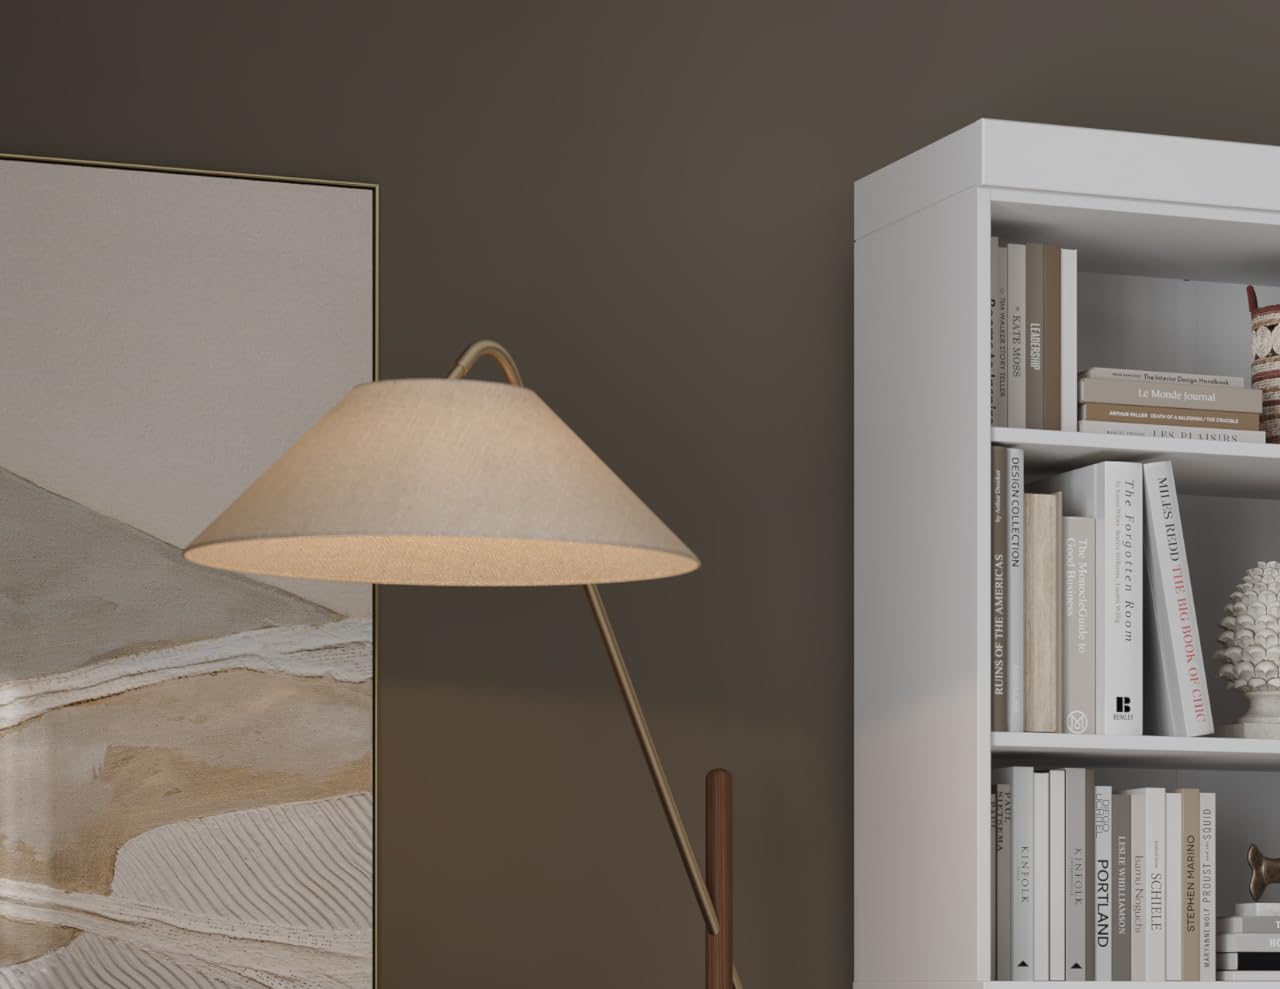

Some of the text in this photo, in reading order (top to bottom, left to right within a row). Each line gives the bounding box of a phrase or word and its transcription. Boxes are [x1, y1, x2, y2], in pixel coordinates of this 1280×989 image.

[1012, 315, 1021, 377] KATE MOSS
[1030, 323, 1041, 370] LEADERSHIP
[1138, 388, 1216, 402] Le Monde Journal
[1011, 457, 1020, 567] DESIGN COLLECTION
[1066, 538, 1076, 617] Good Business
[1122, 480, 1135, 643] The Forgotten Room
[1157, 477, 1206, 724] MILES REDD THE BIG BOOK OF CHIC
[994, 554, 1004, 695] RUINS OF THE AMERICAS
[1021, 846, 1030, 903] KINFOLK
[1074, 848, 1083, 905] KINFOLK
[1097, 860, 1109, 947] PORTLAND
[1133, 855, 1144, 933] Isamu Noguchi
[1151, 873, 1162, 931] SCHIELE
[1187, 835, 1195, 933] STEPHEN MARINO
